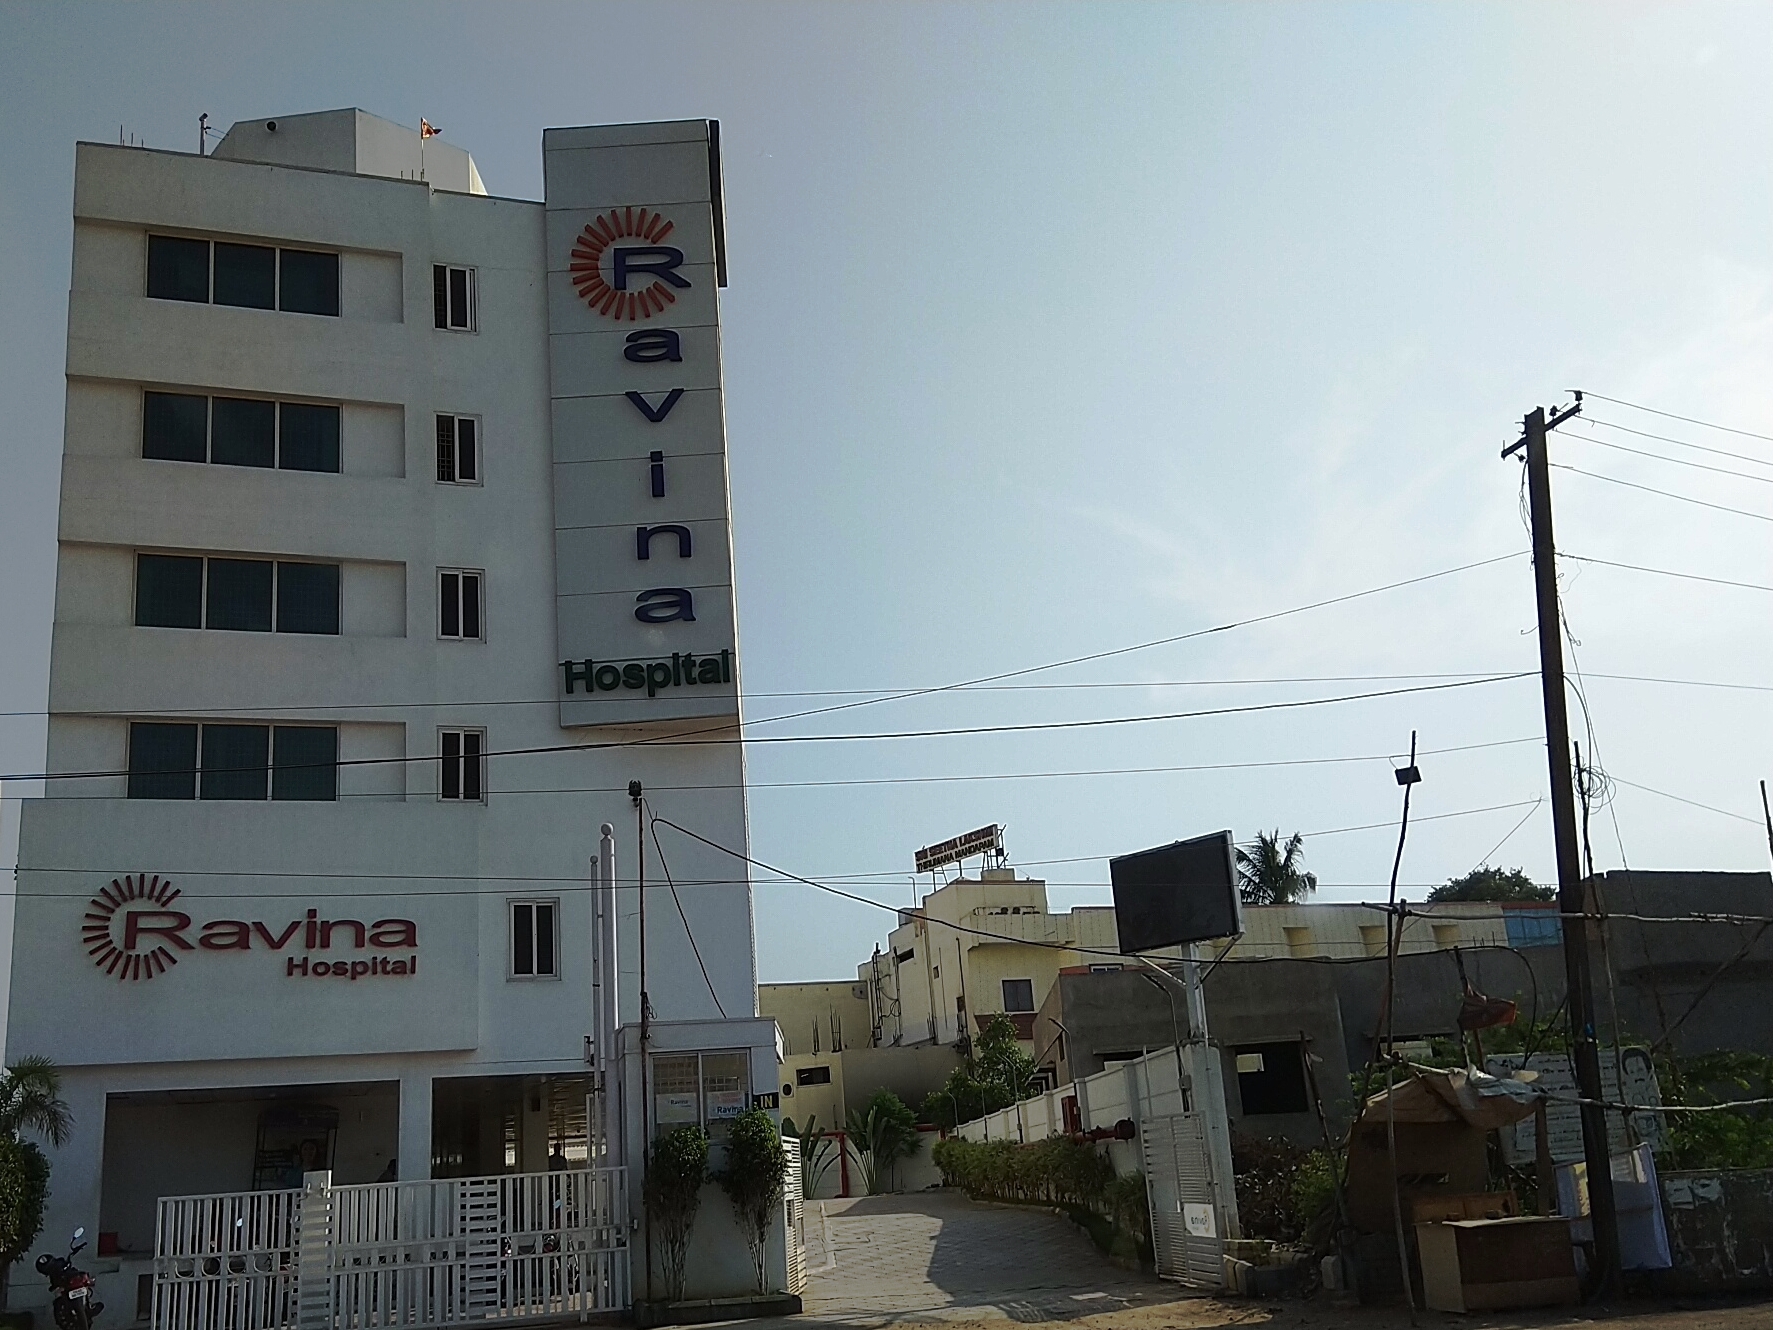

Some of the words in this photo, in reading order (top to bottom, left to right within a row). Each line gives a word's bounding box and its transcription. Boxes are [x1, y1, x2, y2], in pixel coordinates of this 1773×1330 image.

[612, 246, 697, 623] Ravina
[564, 649, 730, 697] Hospital
[123, 908, 419, 950] Ravina
[287, 955, 417, 980] Hospital
[760, 1095, 773, 1108] IN
